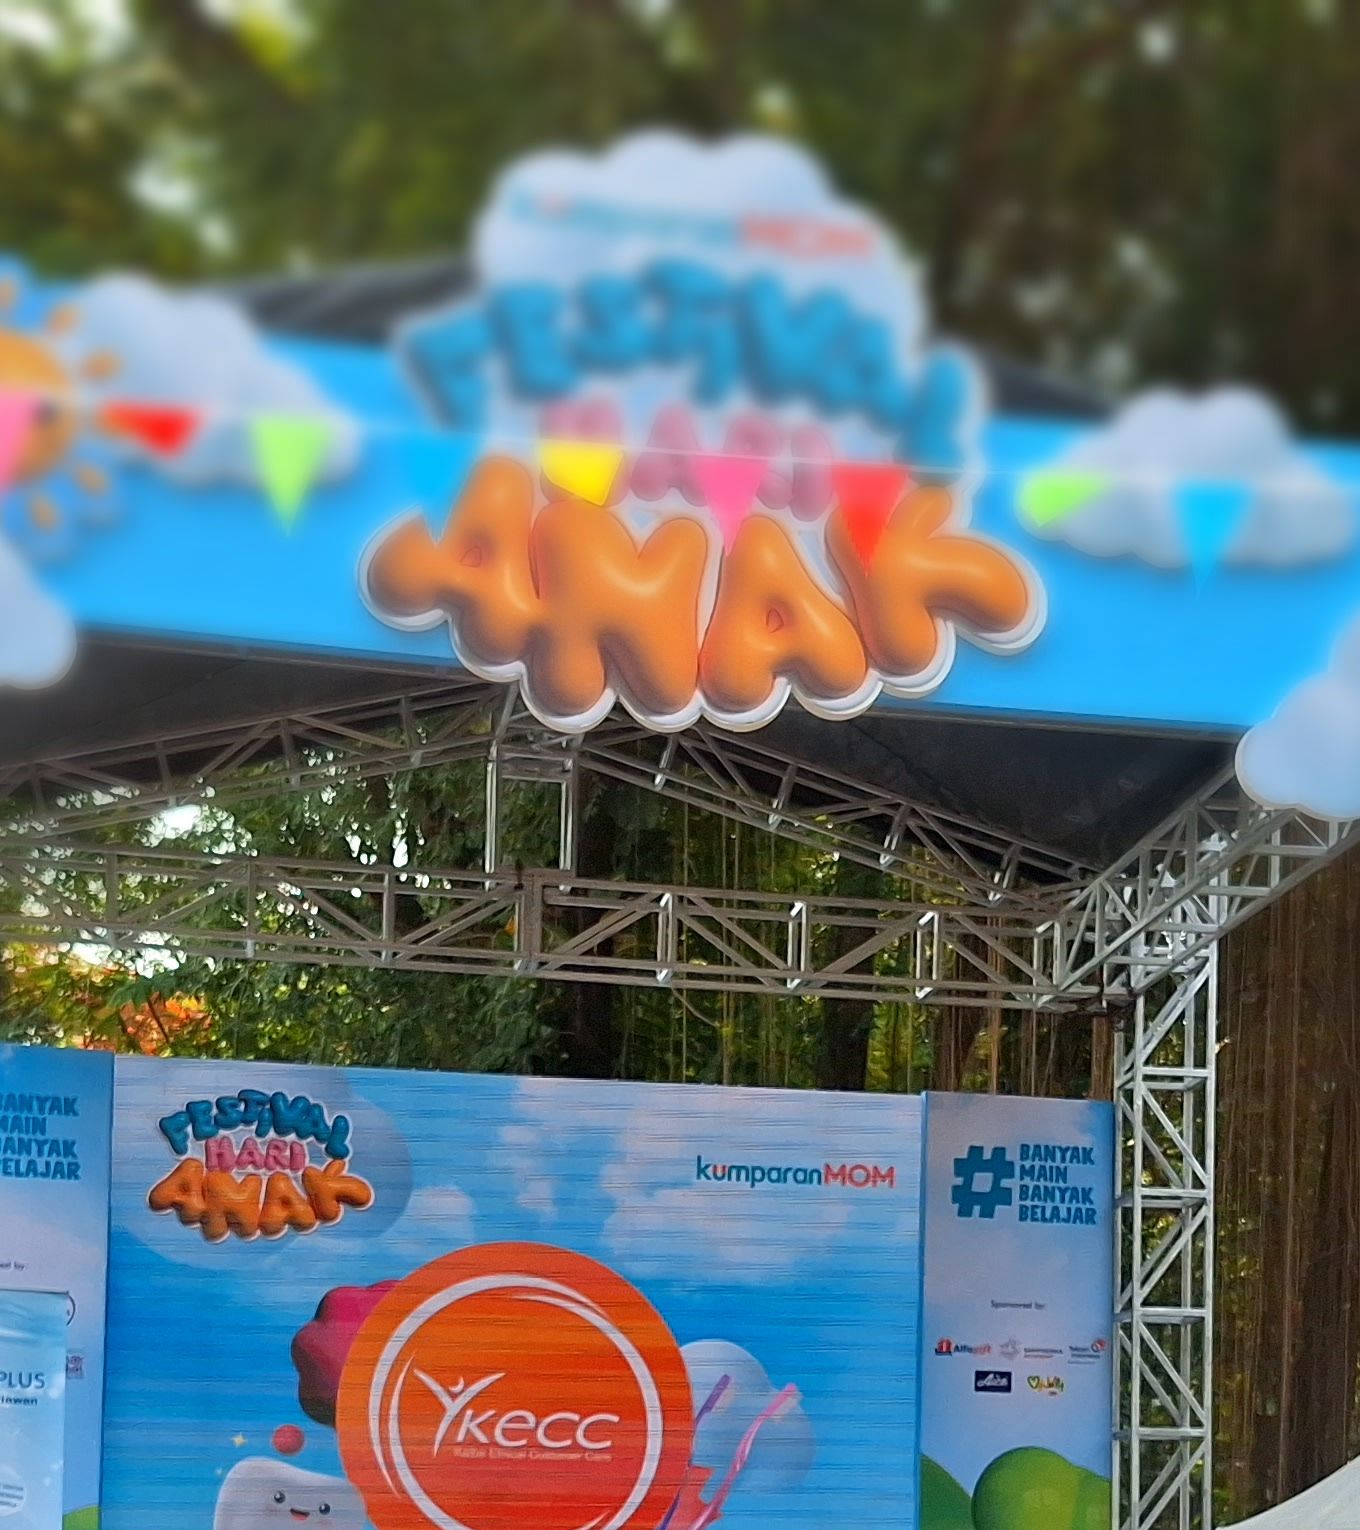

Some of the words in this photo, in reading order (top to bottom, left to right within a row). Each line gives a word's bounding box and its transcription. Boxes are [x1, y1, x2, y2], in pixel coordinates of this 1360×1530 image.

[366, 455, 1032, 716] ANAK
[159, 1088, 350, 1160] FESTIVAL
[204, 1135, 306, 1172] HARI
[1019, 1143, 1095, 1165] BANYAK
[1019, 1164, 1067, 1184] MAIN
[148, 1158, 373, 1244] ANAK
[1019, 1184, 1094, 1205] BANYAK
[1018, 1204, 1097, 1225] BELAJAR
